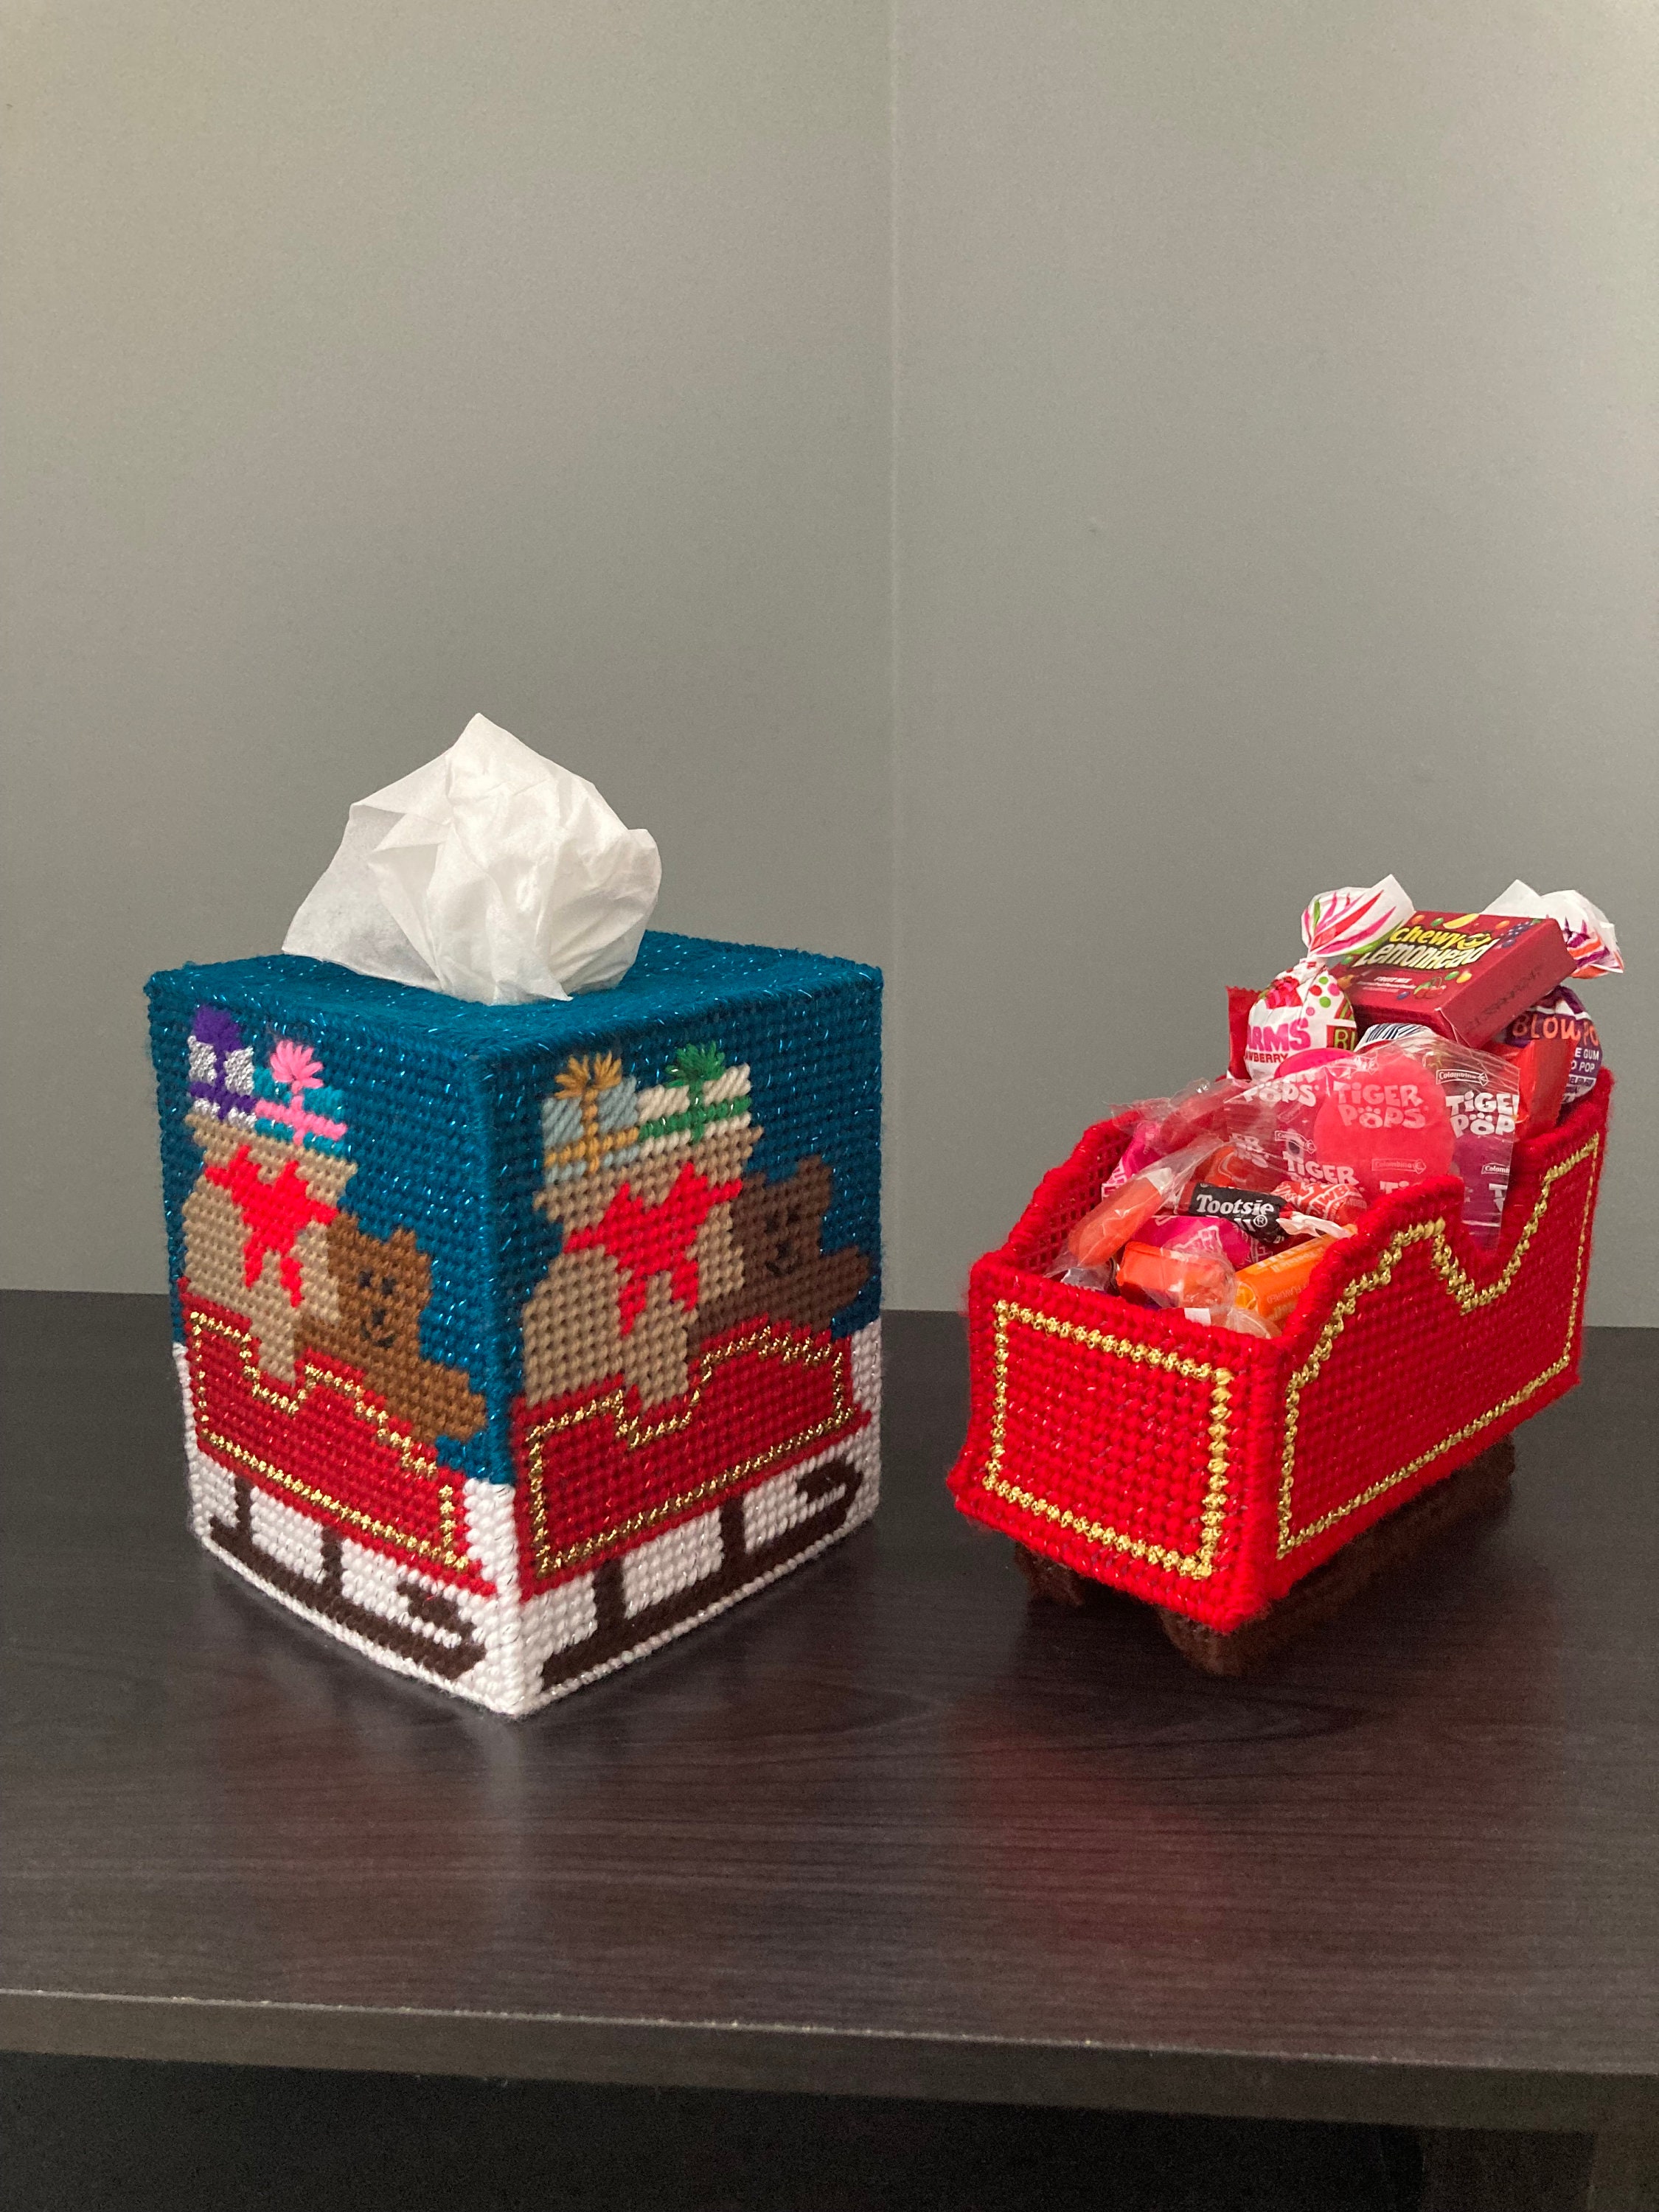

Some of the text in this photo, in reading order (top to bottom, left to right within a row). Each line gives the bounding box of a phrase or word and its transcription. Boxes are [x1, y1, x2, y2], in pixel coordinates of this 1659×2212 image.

[1583, 1049, 1600, 1060] GUM
[1579, 1062, 1595, 1073] POP
[1196, 1194, 1275, 1215] Tootsie
